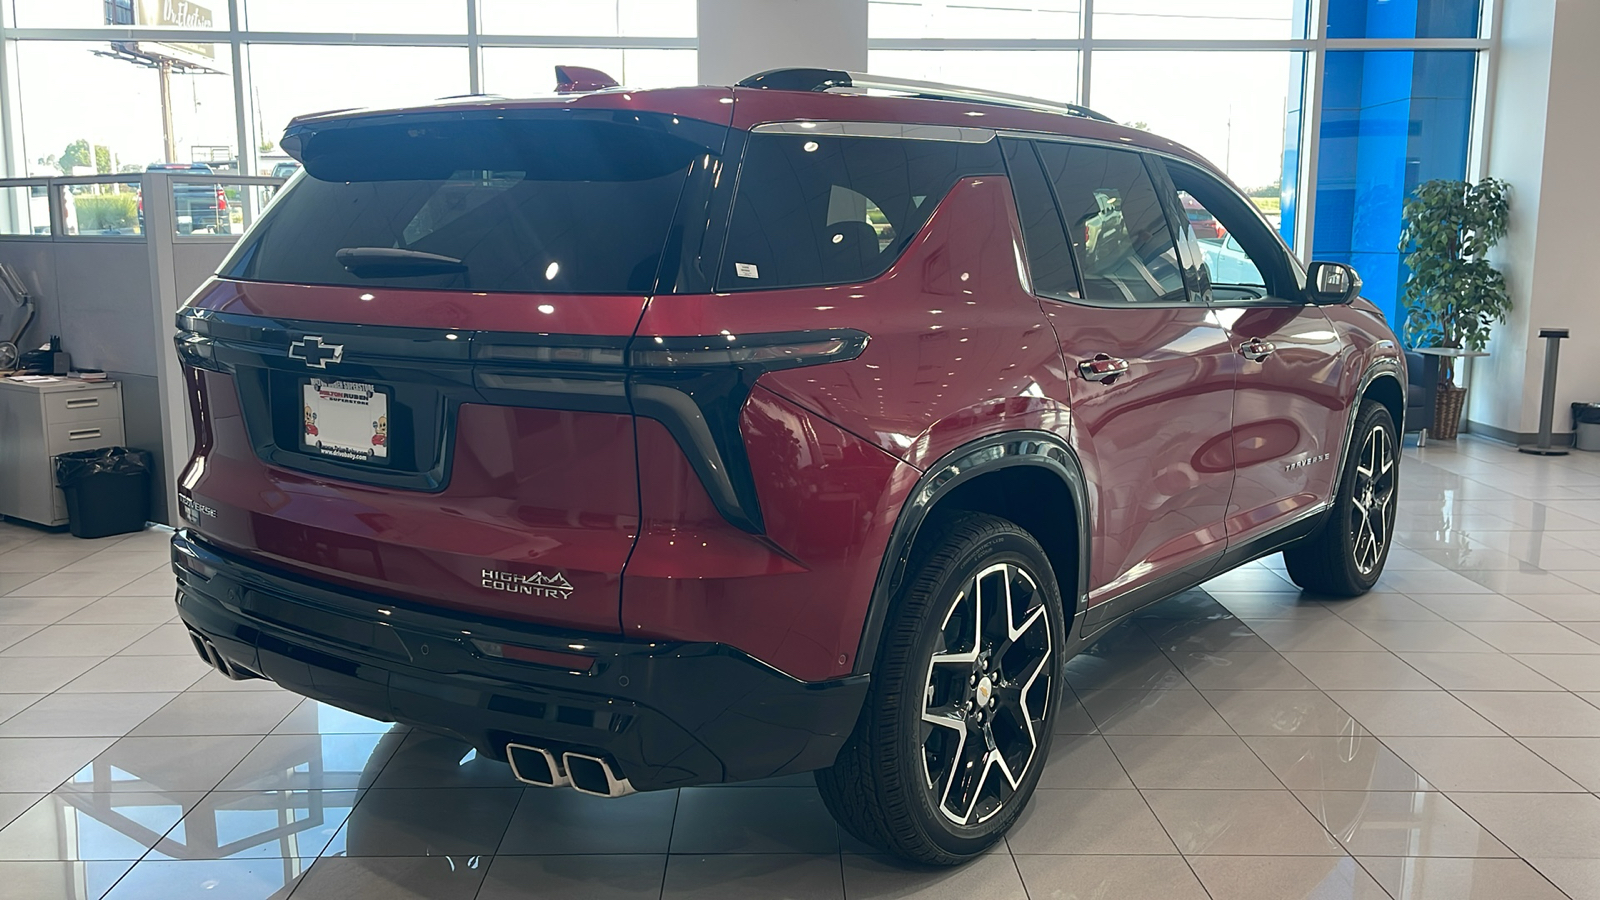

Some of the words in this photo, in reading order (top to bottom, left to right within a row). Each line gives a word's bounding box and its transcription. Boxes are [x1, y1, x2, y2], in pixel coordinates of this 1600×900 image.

[1285, 452, 1330, 472] TRAVERSE
[482, 569, 527, 583] HIGH
[482, 579, 574, 600] COUNTRY
